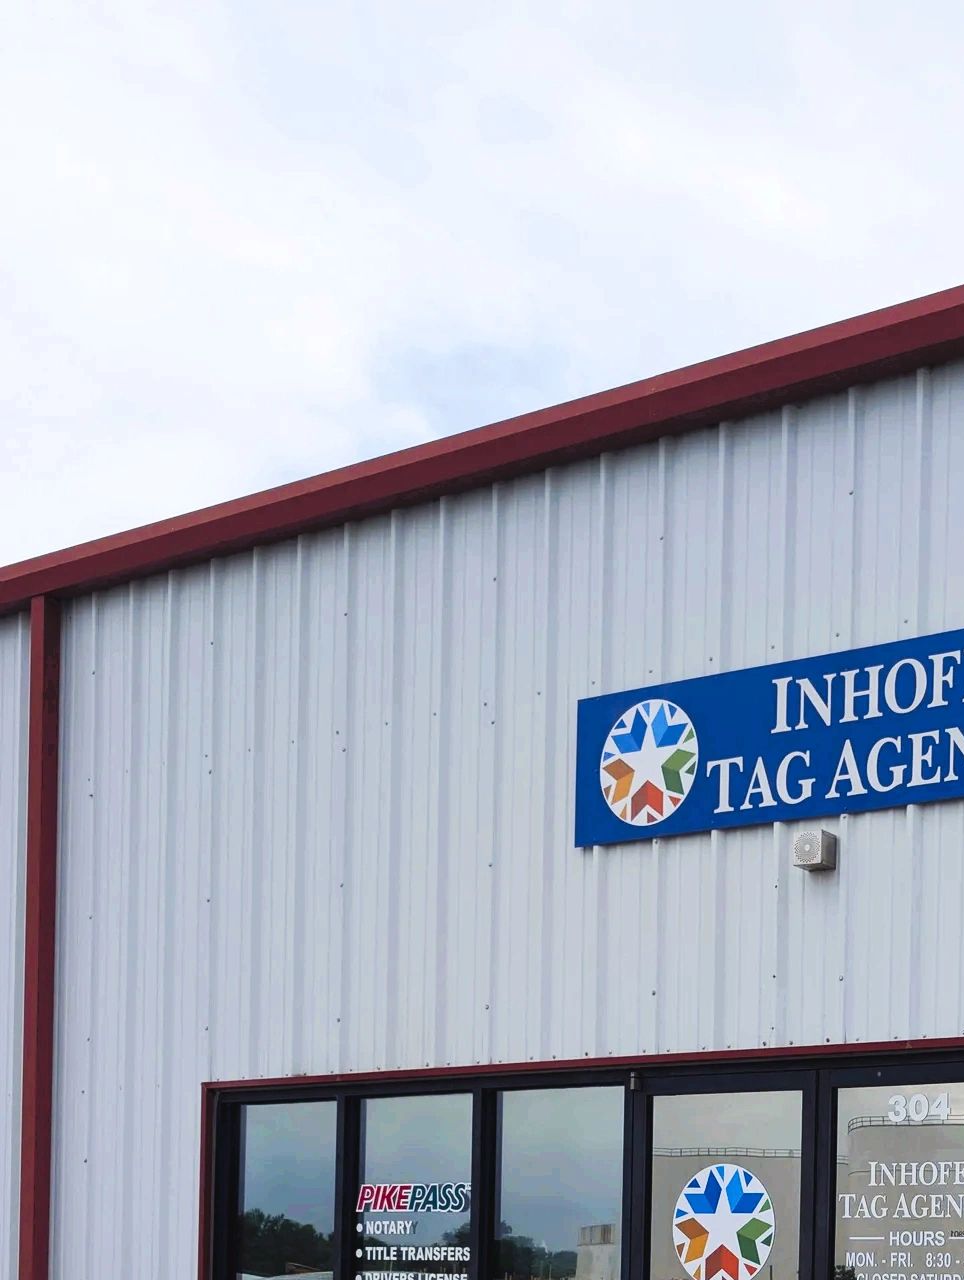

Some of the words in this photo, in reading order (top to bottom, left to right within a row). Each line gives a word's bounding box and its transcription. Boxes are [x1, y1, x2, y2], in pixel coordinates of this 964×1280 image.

[706, 750, 816, 814] TAG
[888, 1092, 950, 1122] 304
[355, 1182, 466, 1213] PIKEPASS
[838, 1193, 888, 1219] TAG
[365, 1220, 413, 1235] NOTARY
[889, 1230, 945, 1247] HOURS
[365, 1246, 397, 1261] TITLE
[401, 1246, 471, 1262] TRANSFERS
[845, 1252, 878, 1268] MON.
[890, 1252, 914, 1268] FRI.
[925, 1252, 951, 1268] 8:30
